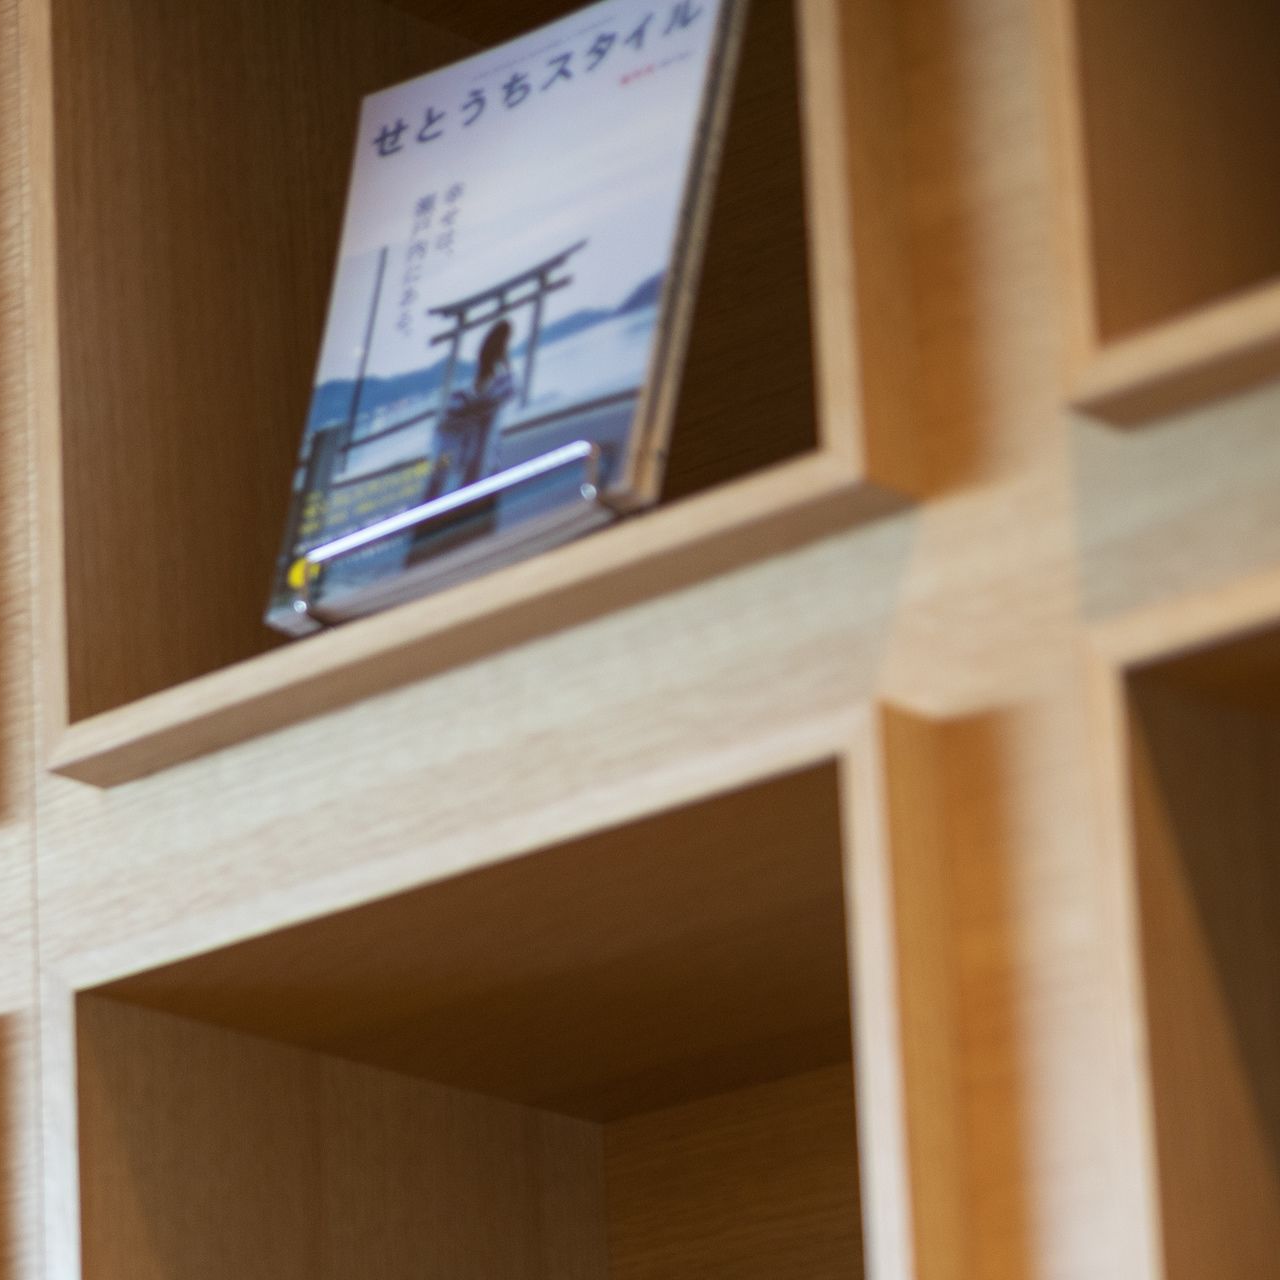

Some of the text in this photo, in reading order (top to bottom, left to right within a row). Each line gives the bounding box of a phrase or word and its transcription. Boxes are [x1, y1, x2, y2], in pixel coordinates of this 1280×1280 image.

[371, 1, 704, 158] せとうちスタイル
